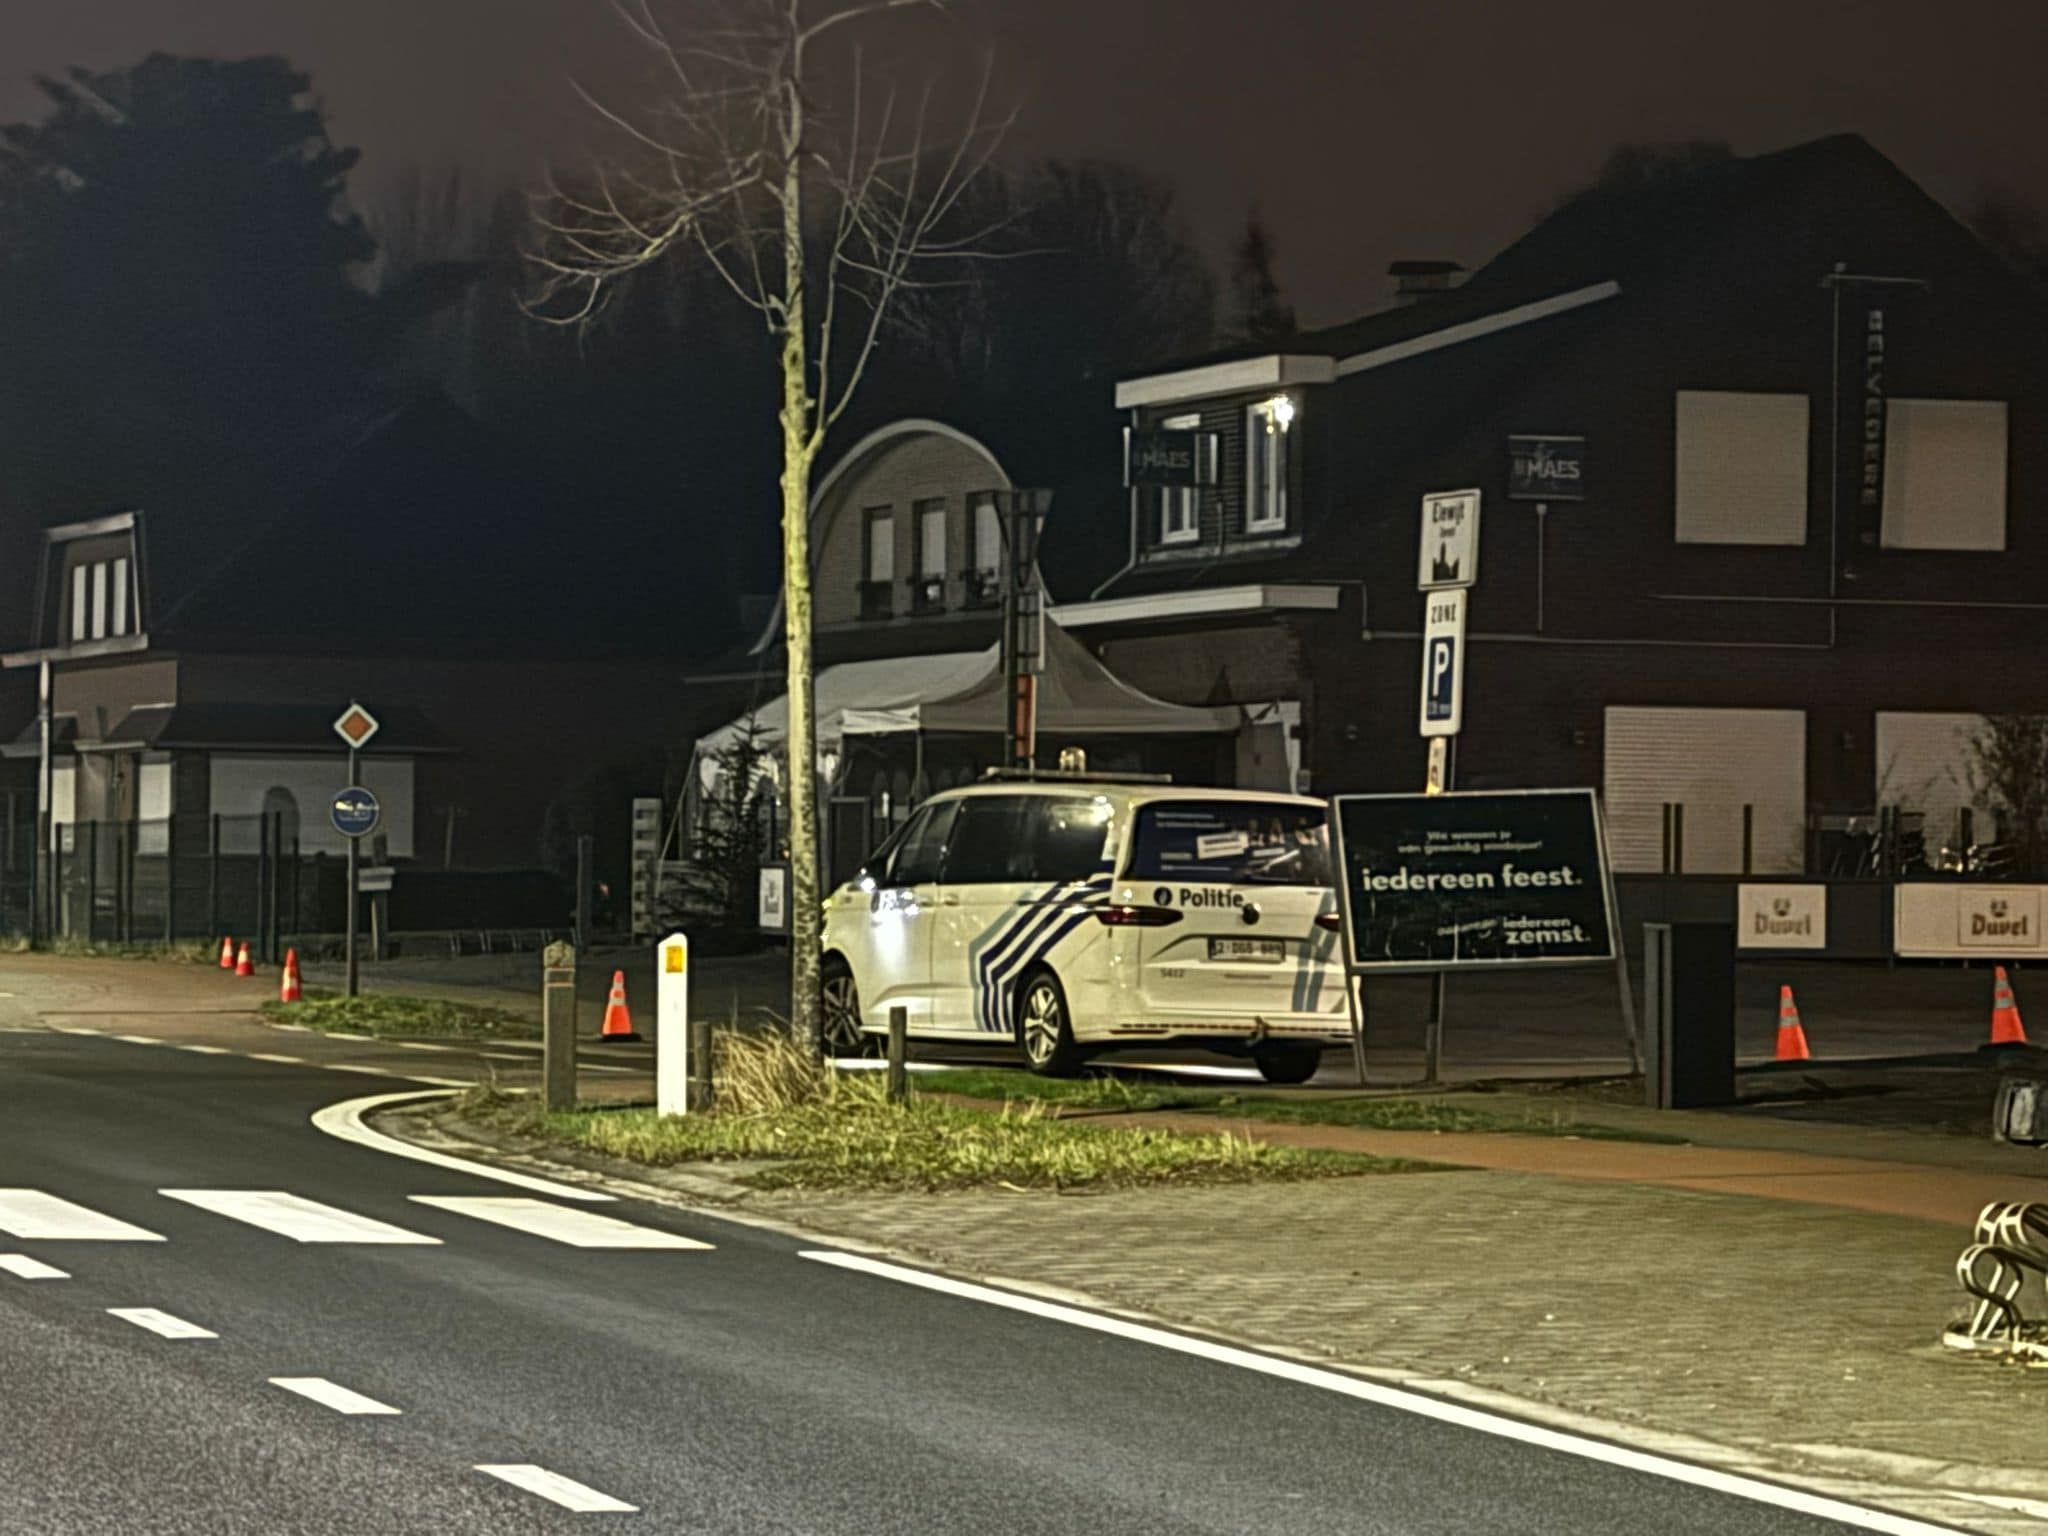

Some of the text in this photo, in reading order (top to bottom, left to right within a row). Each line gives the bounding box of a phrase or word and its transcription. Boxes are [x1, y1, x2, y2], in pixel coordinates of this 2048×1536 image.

[1527, 459, 1580, 479] MAES
[1431, 603, 1457, 624] ZONE
[1362, 863, 1584, 892] iedereen feest.
[1179, 888, 1244, 910] Politie
[1502, 916, 1571, 928] iedereen
[1754, 912, 1811, 936] Duvel
[1971, 912, 2028, 936] Duvel
[1505, 925, 1591, 945] zemst.
